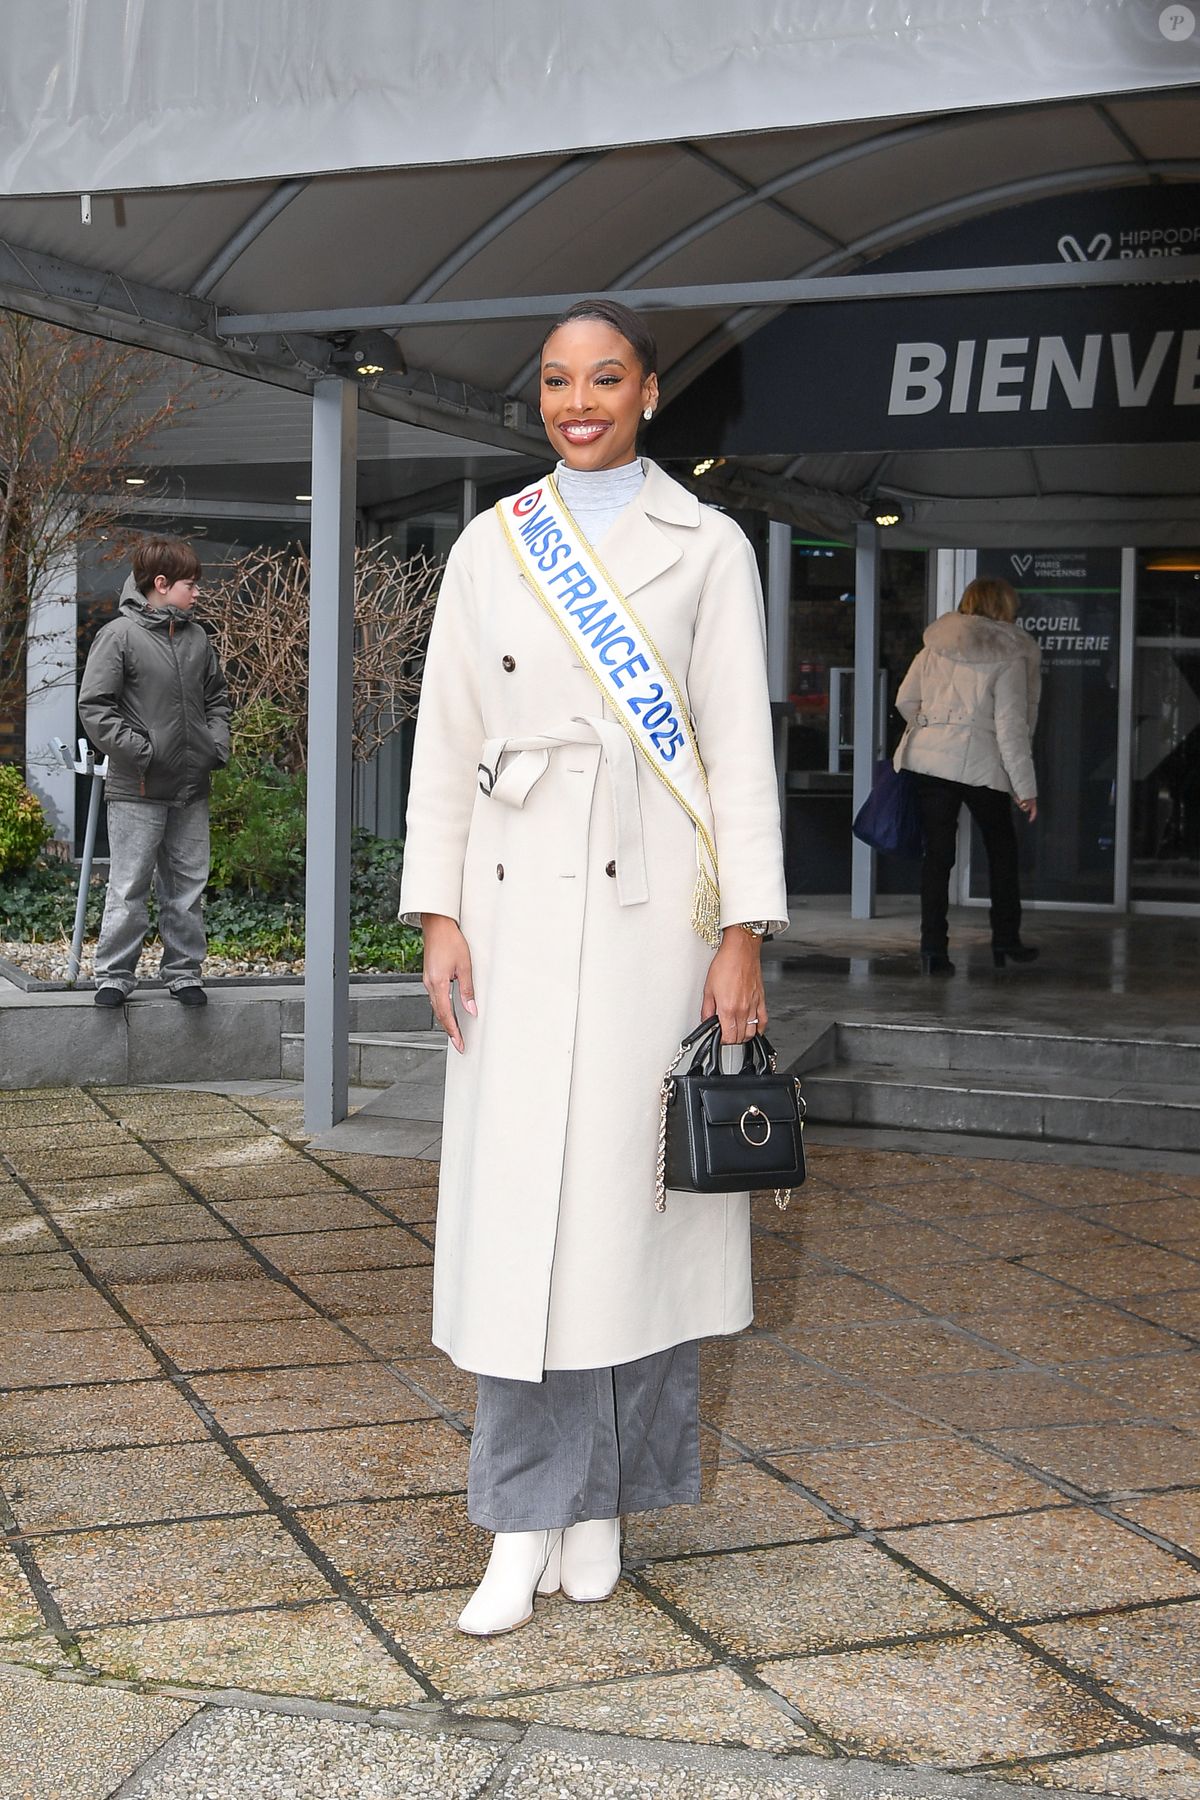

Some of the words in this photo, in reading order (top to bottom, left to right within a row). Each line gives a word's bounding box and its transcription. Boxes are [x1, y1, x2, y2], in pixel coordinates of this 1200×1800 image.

[1034, 569, 1087, 577] VINCENNES
[1015, 617, 1081, 631] ACCUEIL
[518, 504, 572, 572] MISS
[547, 561, 650, 689] FRANCE
[626, 683, 685, 762] 2025
